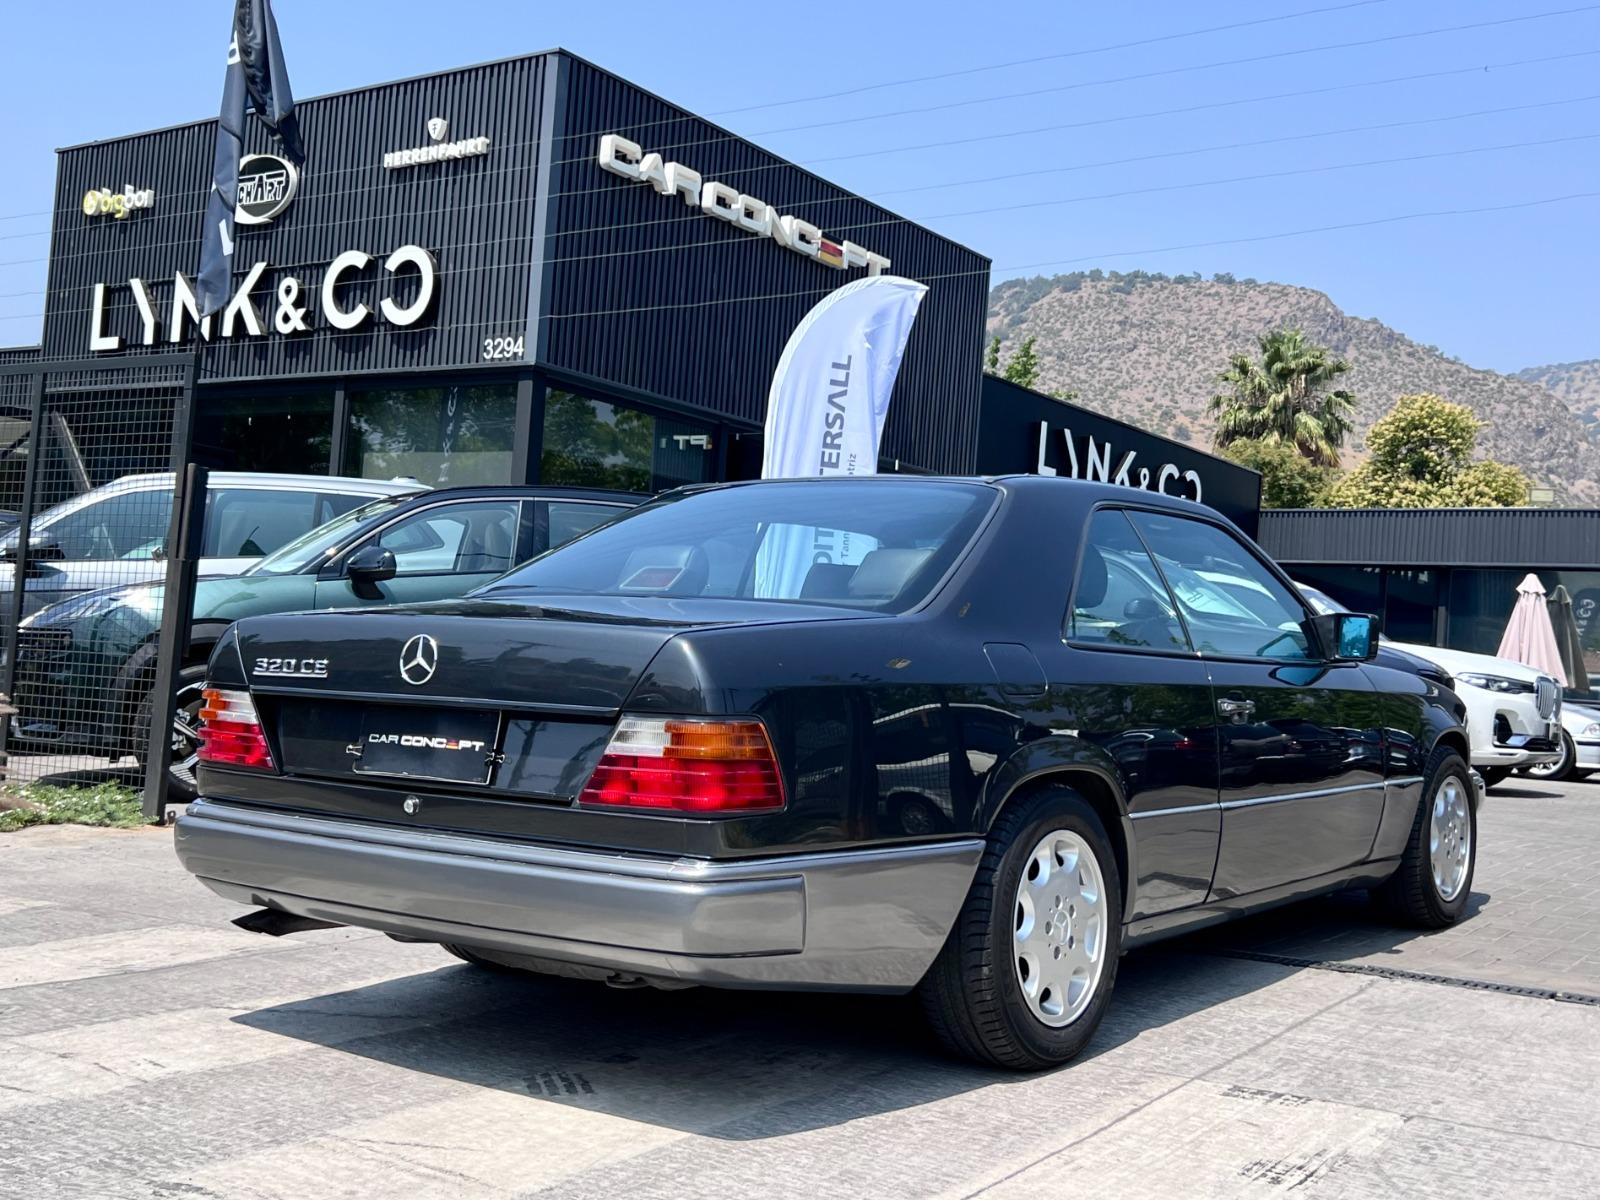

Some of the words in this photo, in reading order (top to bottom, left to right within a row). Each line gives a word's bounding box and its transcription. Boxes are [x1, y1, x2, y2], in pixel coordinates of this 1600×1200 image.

[383, 136, 490, 169] HERRENFAHRT
[599, 134, 702, 207] CAR
[238, 169, 287, 206] CHART
[483, 336, 524, 360] 3294
[819, 354, 852, 476] ERSALL
[254, 657, 297, 673] 320
[300, 658, 329, 674] CE
[368, 733, 399, 744] CAR
